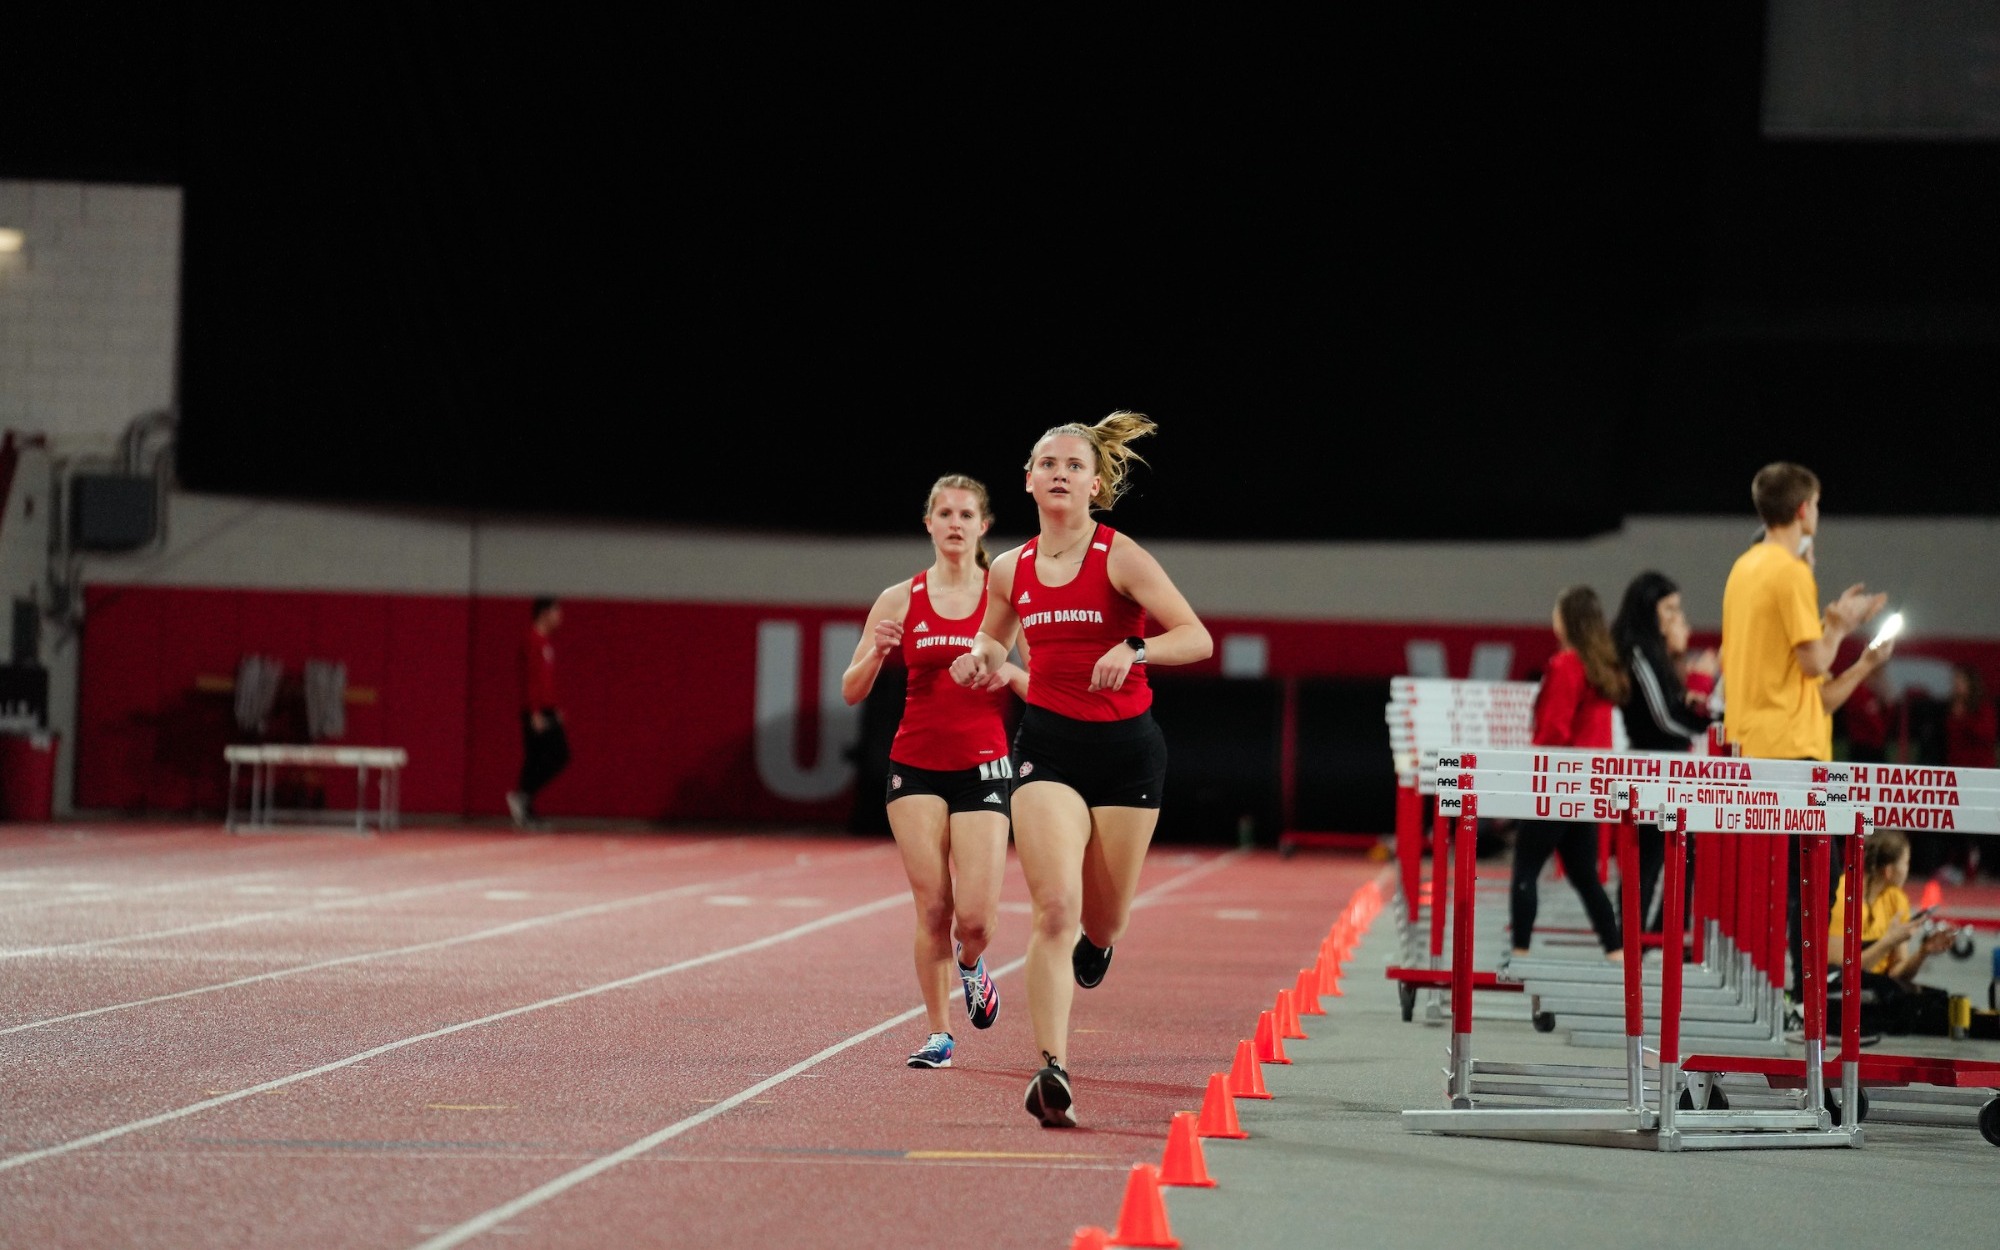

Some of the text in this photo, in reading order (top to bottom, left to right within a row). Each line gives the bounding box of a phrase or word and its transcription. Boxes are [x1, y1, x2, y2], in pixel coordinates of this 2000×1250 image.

[1022, 609, 1103, 629] SOUTH DAKOTA
[916, 636, 974, 649] SOUTH DAKO
[1557, 762, 1583, 773] OF
[1592, 757, 1661, 776] SOUTH
[1669, 760, 1752, 780] DAKOTA
[1876, 768, 1957, 787] DAKOTA
[1556, 782, 1582, 794] OF
[1697, 789, 1733, 805] SOUTH
[1737, 790, 1778, 805] DAKOTA
[1879, 788, 1960, 806] DAKOTA
[1536, 796, 1550, 816] U
[1560, 802, 1585, 818] OF
[1715, 807, 1826, 831] U OF SOUTH DAKOTA
[1873, 806, 1955, 829] DAKOTA
